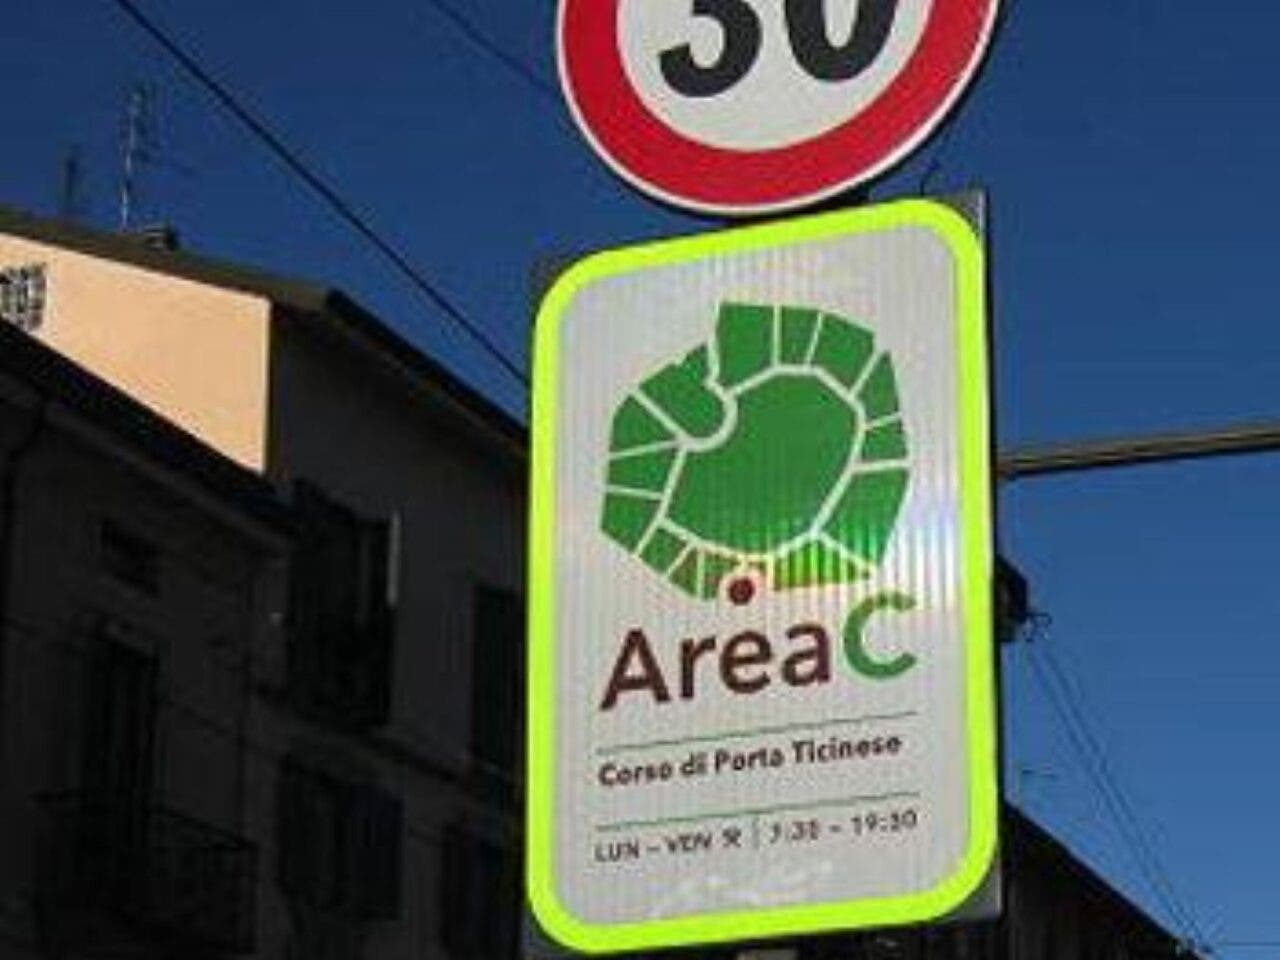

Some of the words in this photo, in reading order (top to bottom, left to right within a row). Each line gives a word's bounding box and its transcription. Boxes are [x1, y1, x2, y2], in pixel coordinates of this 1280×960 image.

[658, 0, 897, 98] 30
[598, 759, 670, 788] Corso
[679, 749, 707, 778] di
[714, 746, 786, 773] Porta
[792, 734, 903, 764] Ticinese
[594, 840, 641, 864] LUN
[667, 832, 714, 855] VEN
